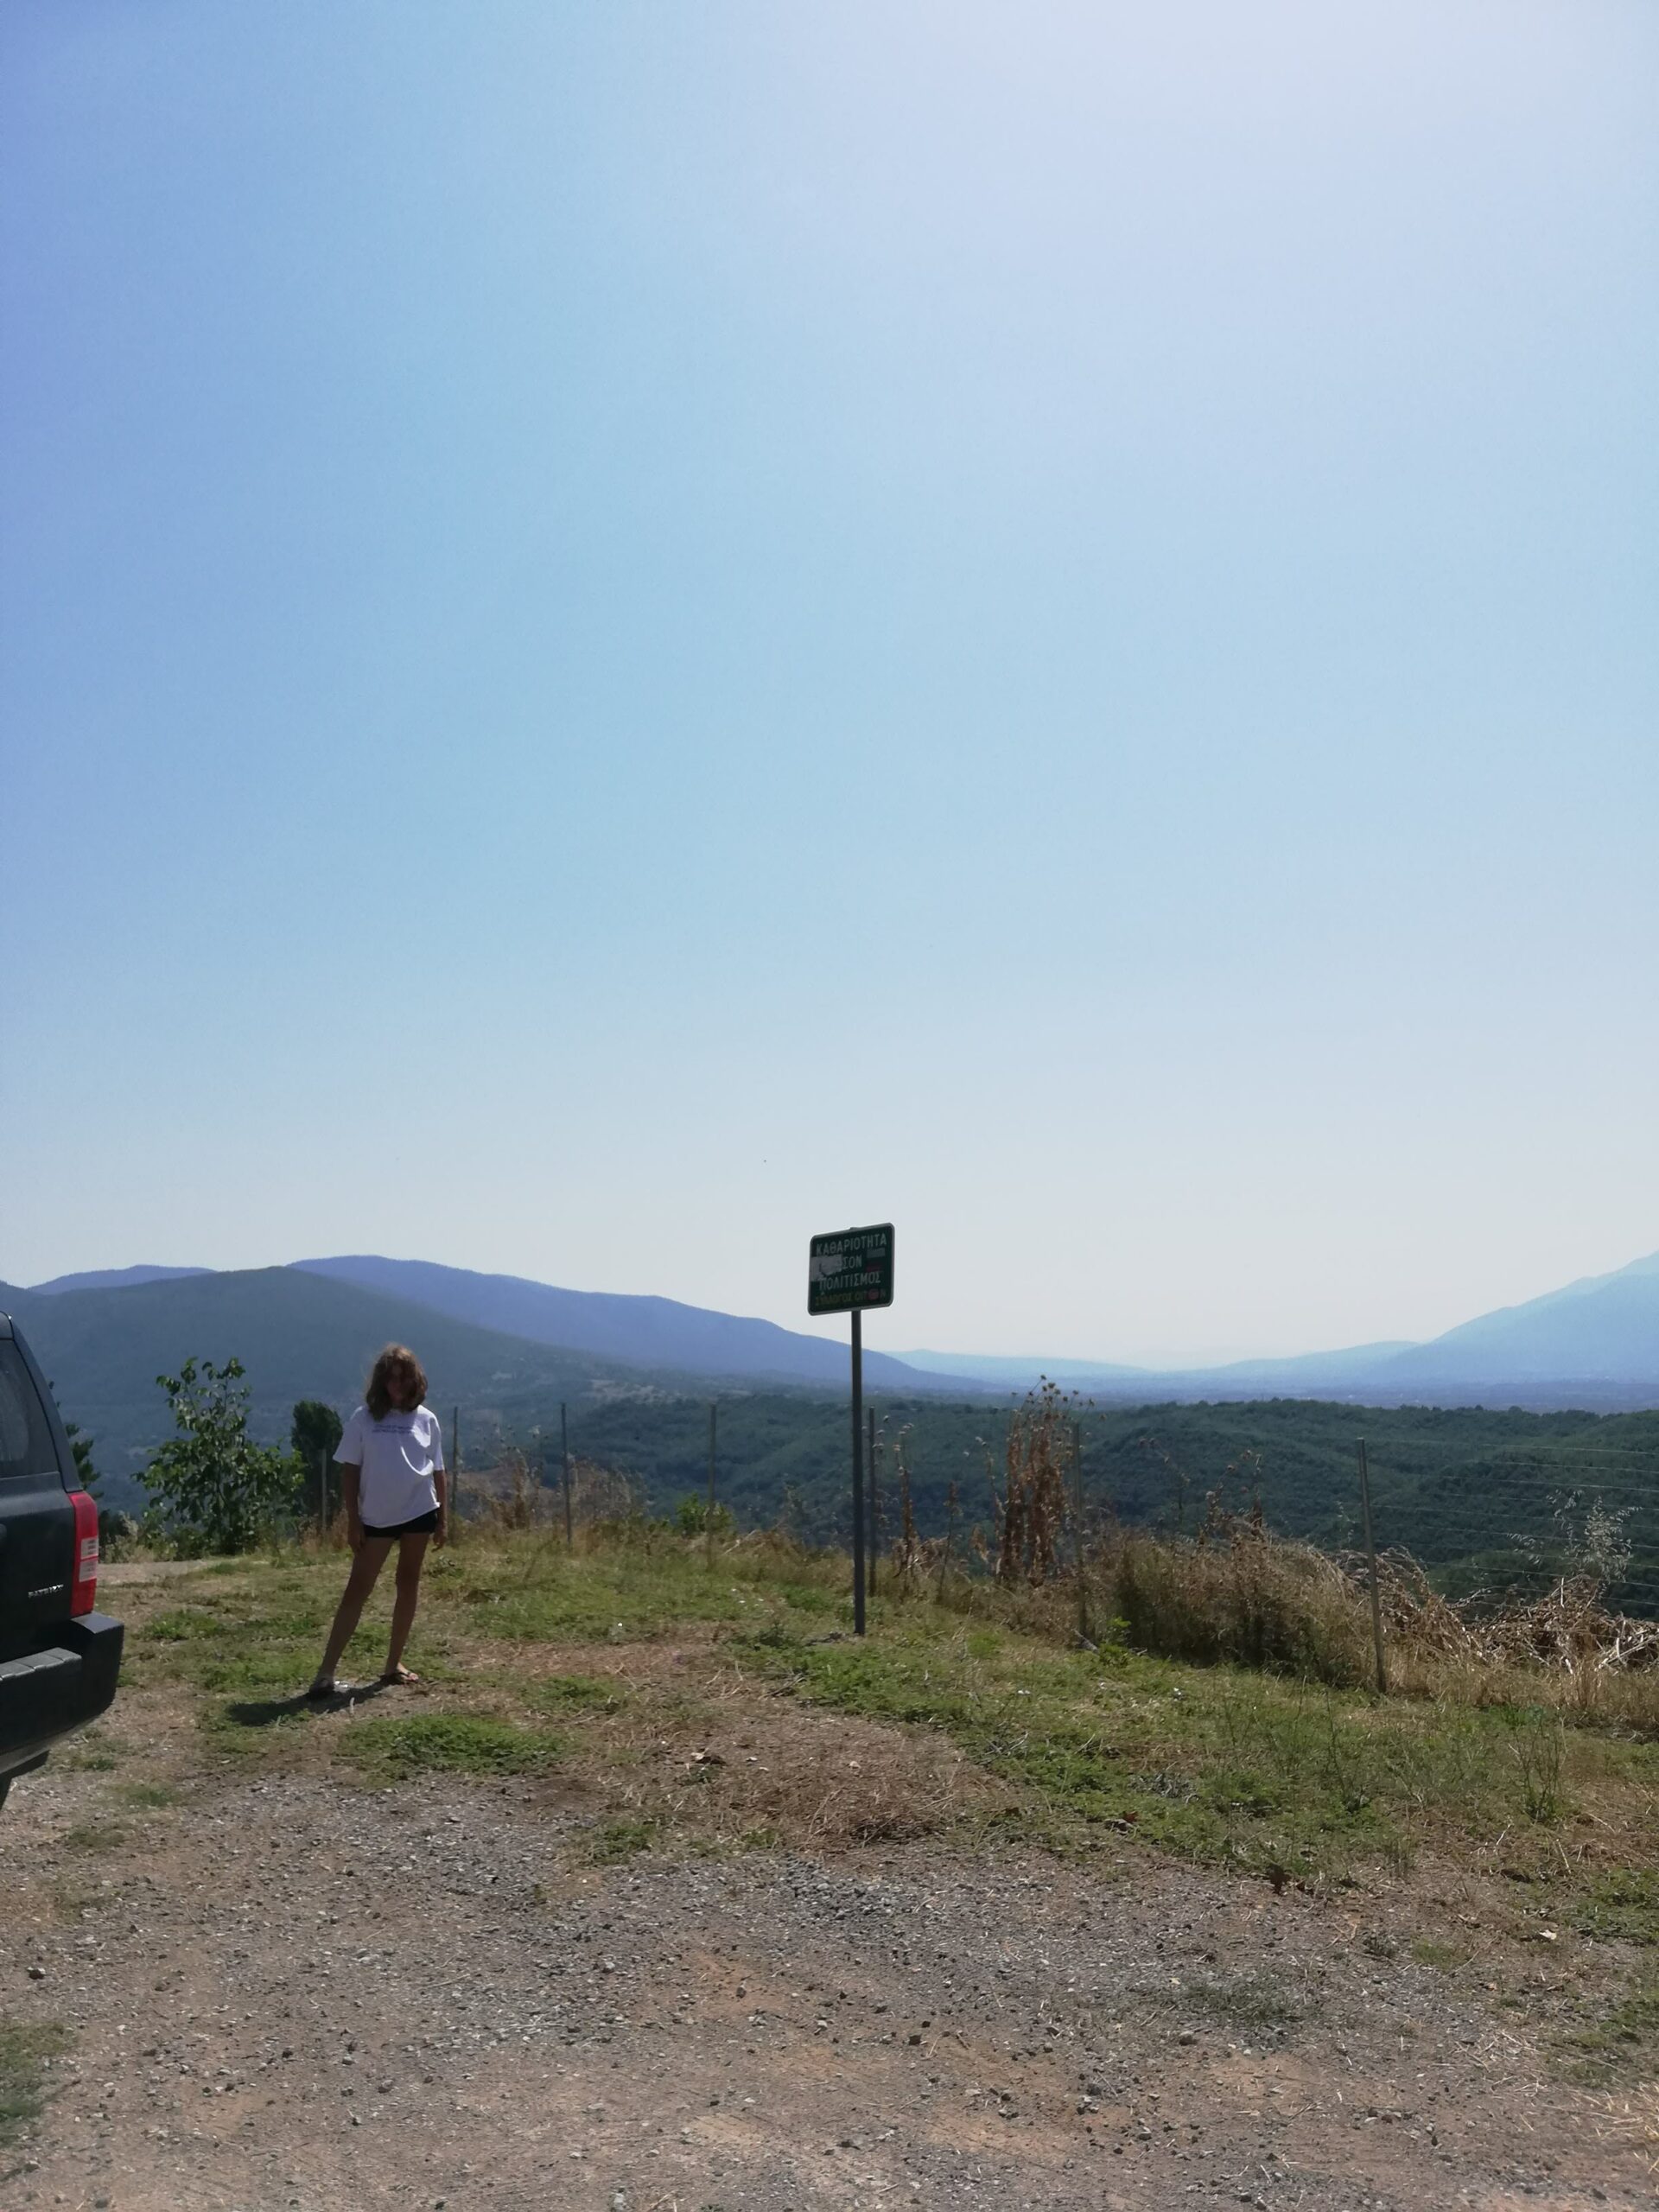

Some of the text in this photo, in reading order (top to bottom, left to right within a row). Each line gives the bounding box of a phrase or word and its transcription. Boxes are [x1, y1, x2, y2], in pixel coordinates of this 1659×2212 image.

[816, 1233, 887, 1255] ΚΑΘΑΡΙΟΤΗΤΑ
[841, 1255, 862, 1270] ΣΟΝ
[819, 1272, 880, 1290] ΠΟΛΙΤΙΣΜΟΣ
